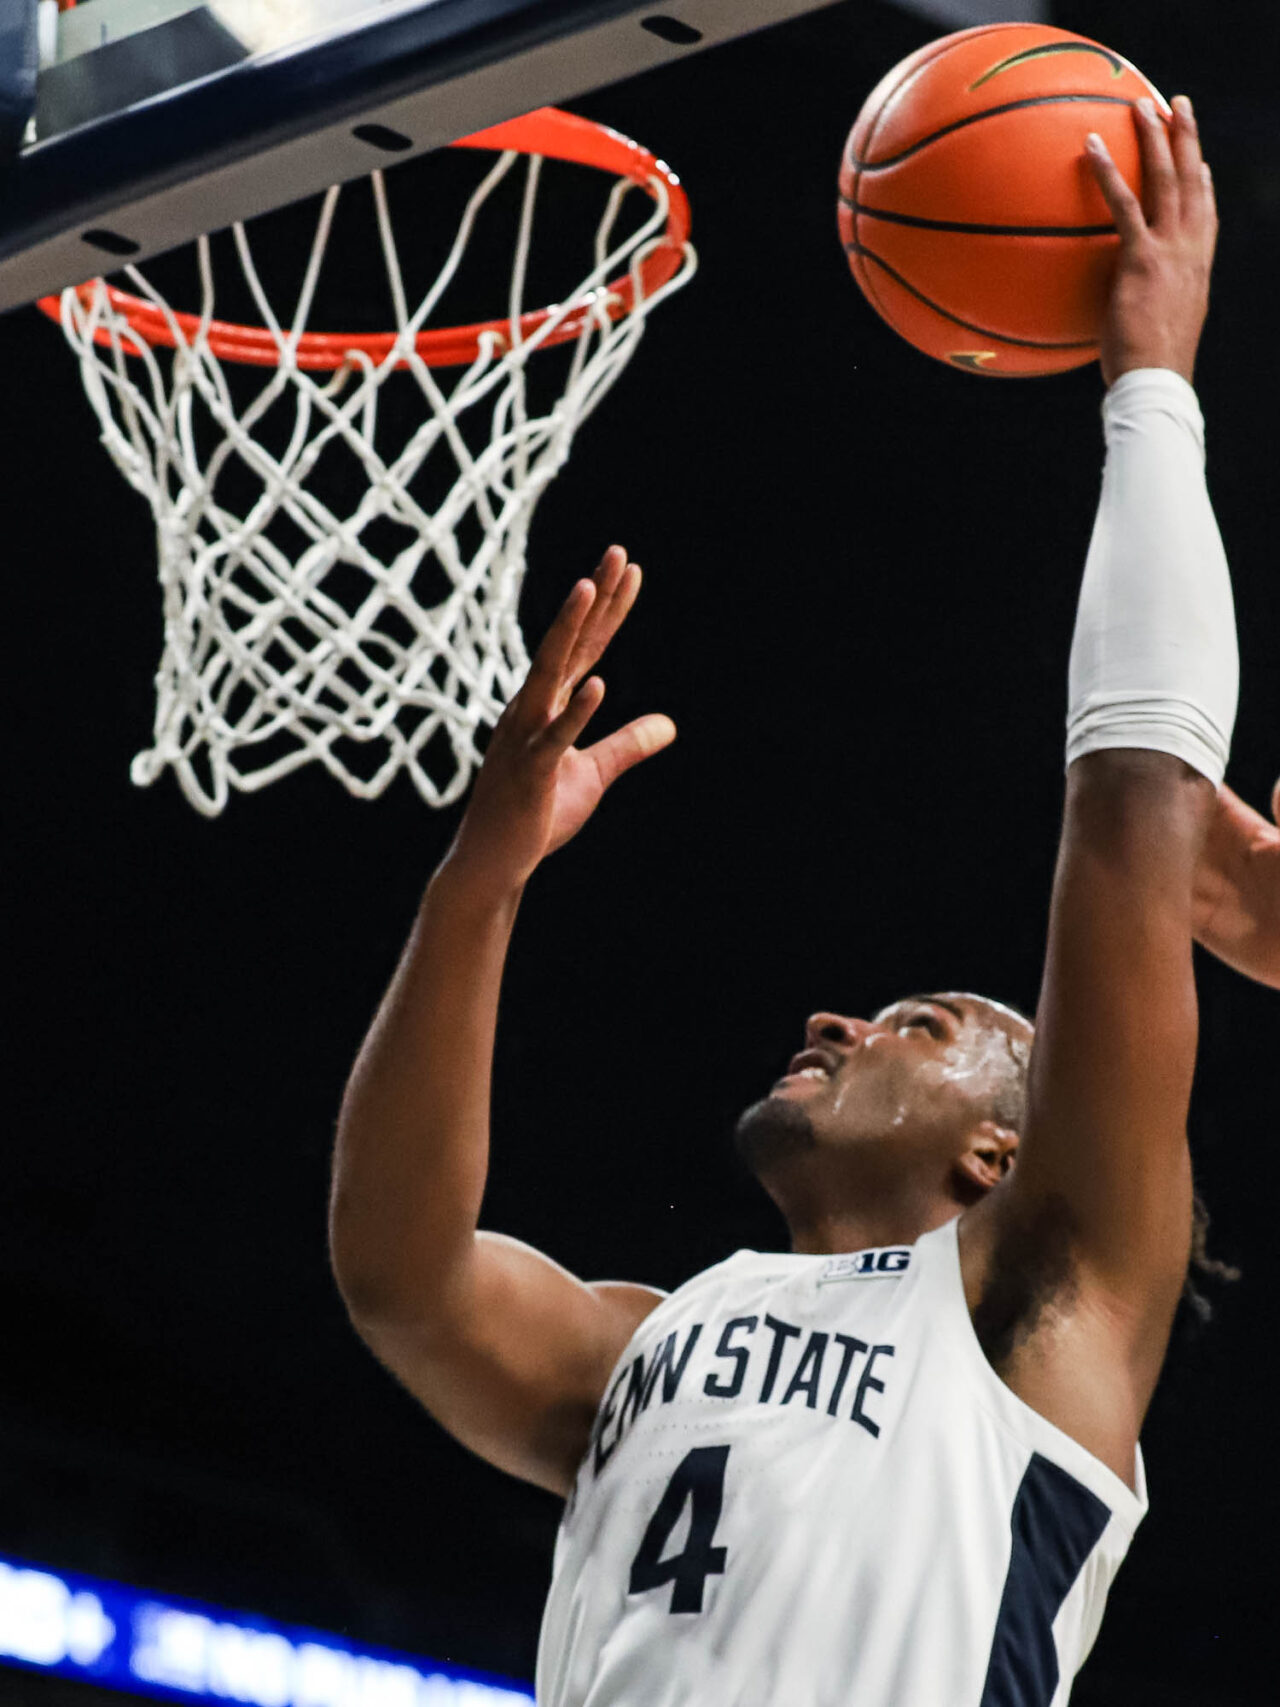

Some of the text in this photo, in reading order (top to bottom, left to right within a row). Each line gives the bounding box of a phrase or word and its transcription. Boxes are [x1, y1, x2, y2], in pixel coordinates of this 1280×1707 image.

[570, 1312, 896, 1510] ENN STATE
[627, 1443, 731, 1615] 4
